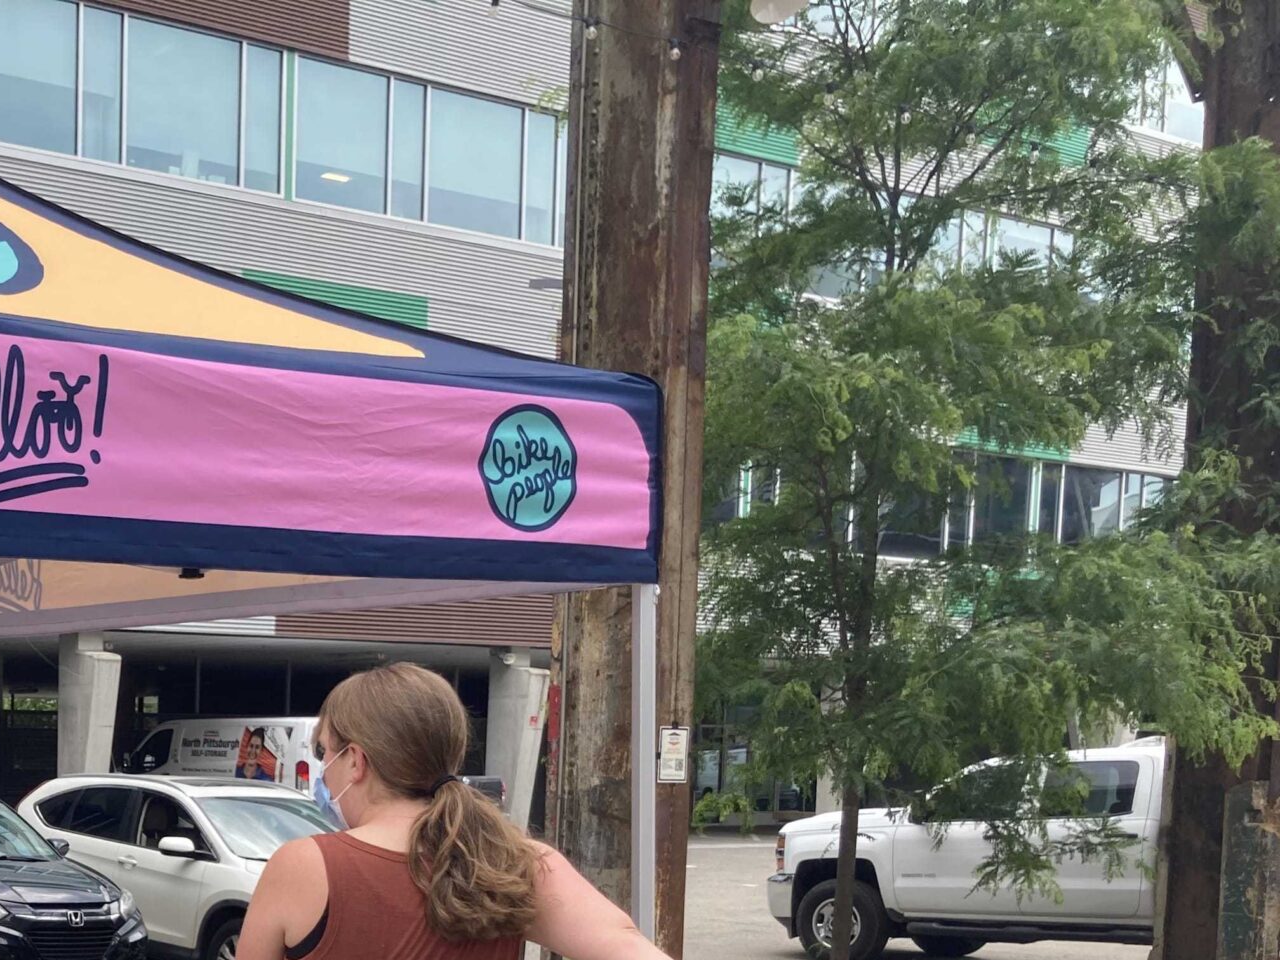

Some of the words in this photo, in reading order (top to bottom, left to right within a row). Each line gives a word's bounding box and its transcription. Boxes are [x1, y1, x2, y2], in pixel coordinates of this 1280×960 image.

[487, 424, 553, 484] bike
[506, 446, 571, 522] people
[182, 737, 201, 748] North
[203, 738, 240, 751] Pittsburgh
